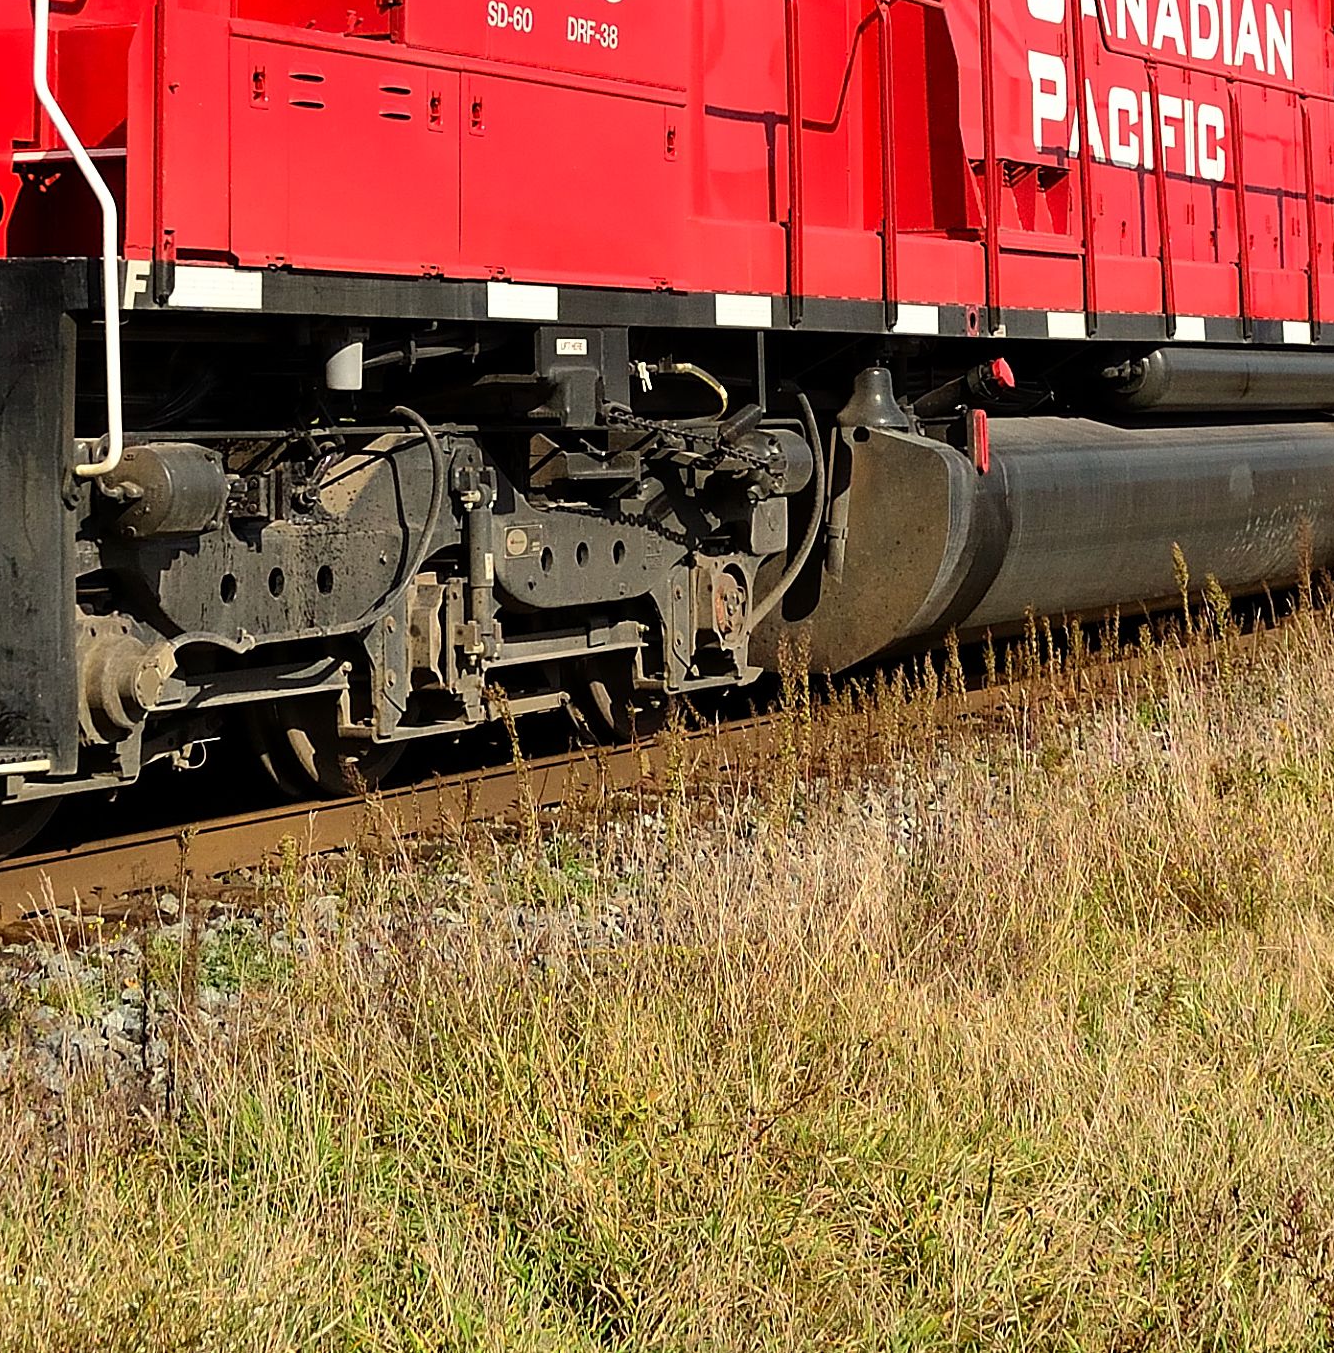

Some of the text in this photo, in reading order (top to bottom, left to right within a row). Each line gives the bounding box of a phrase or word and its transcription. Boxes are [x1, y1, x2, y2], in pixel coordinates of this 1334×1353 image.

[487, 0, 619, 50] SD-60 DRF-38
[1028, 49, 1226, 182] PACIFIC
[123, 259, 151, 310] F
